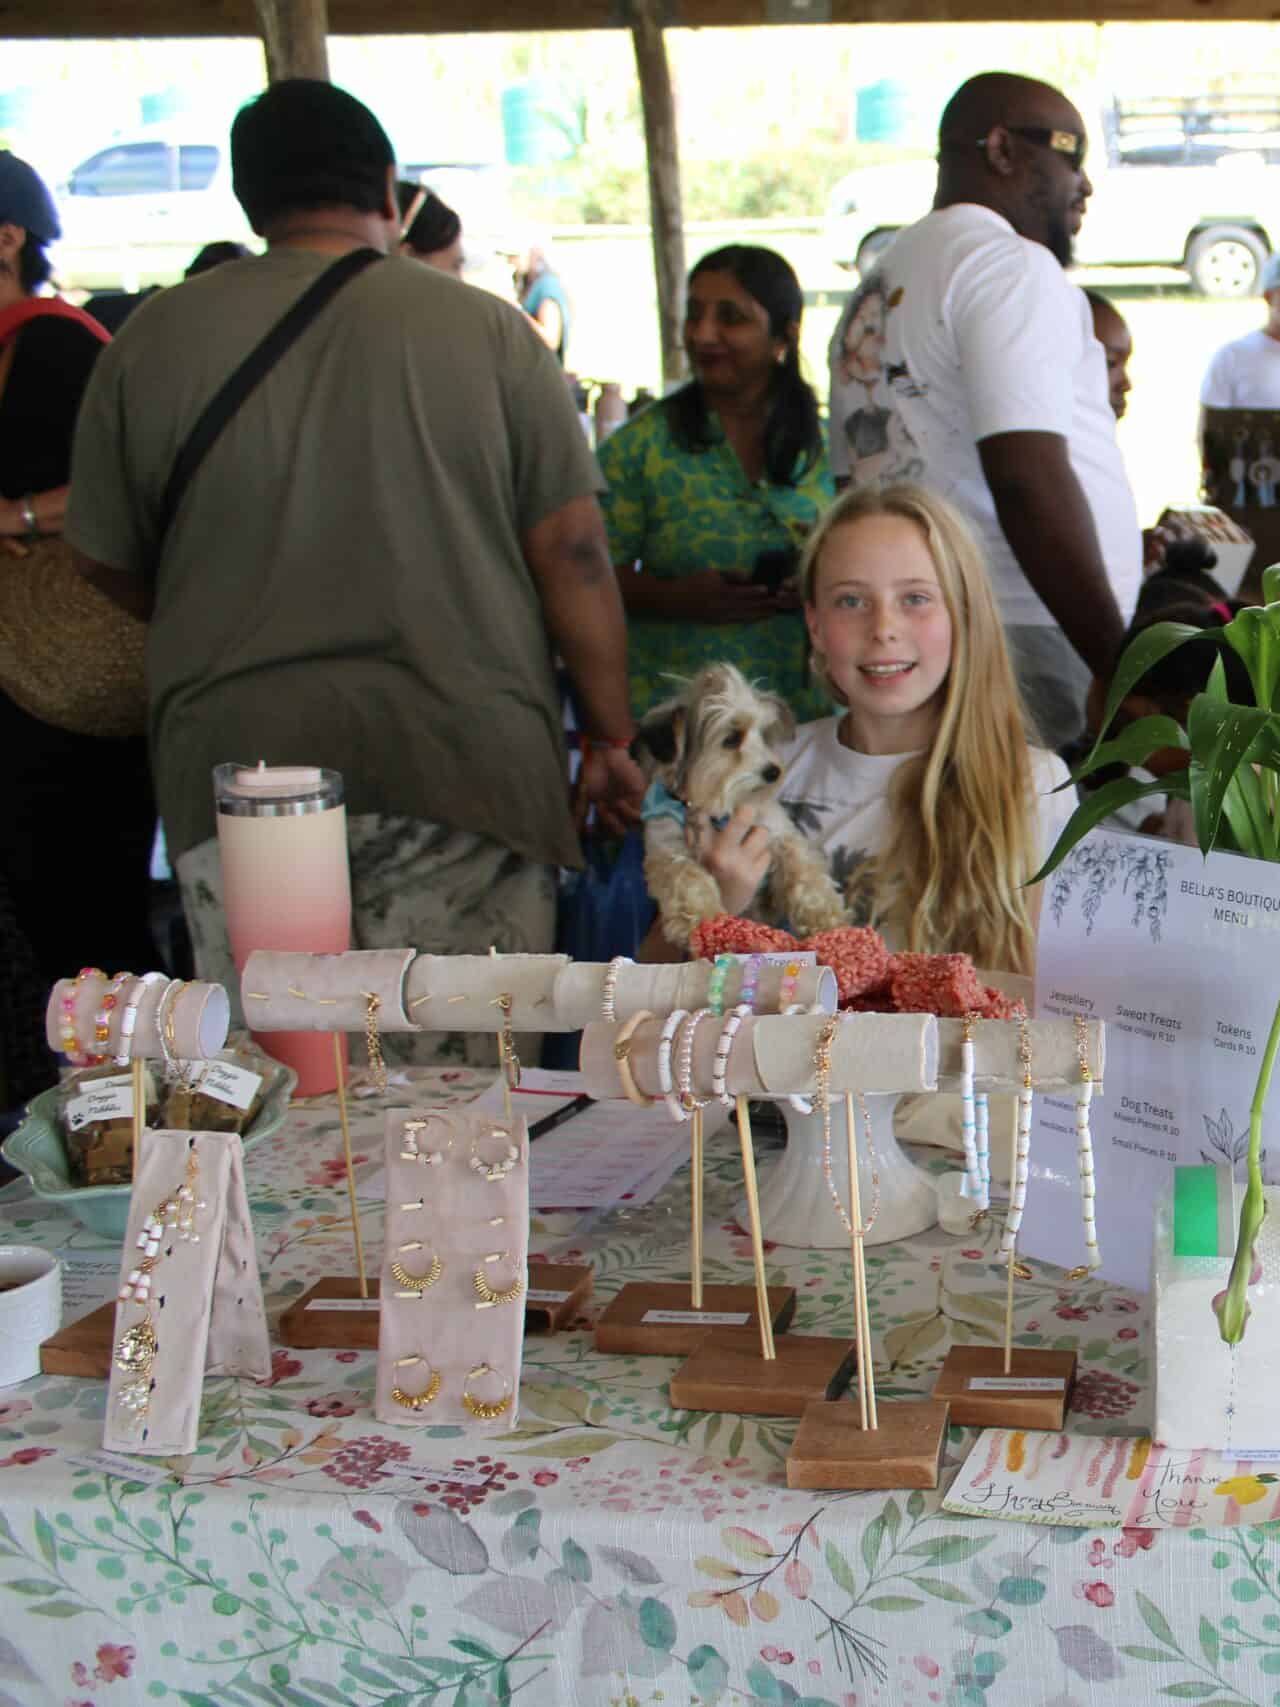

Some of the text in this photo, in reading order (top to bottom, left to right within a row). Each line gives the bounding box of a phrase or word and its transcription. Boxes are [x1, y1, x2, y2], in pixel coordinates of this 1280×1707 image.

[1180, 880, 1224, 901] BELLA'S
[1213, 908, 1249, 926] MENU
[1150, 1012, 1183, 1030] Treats
[1216, 1021, 1252, 1039] Tokens
[1214, 1038, 1236, 1051] Cards
[1121, 1096, 1174, 1120] Dog Treats
